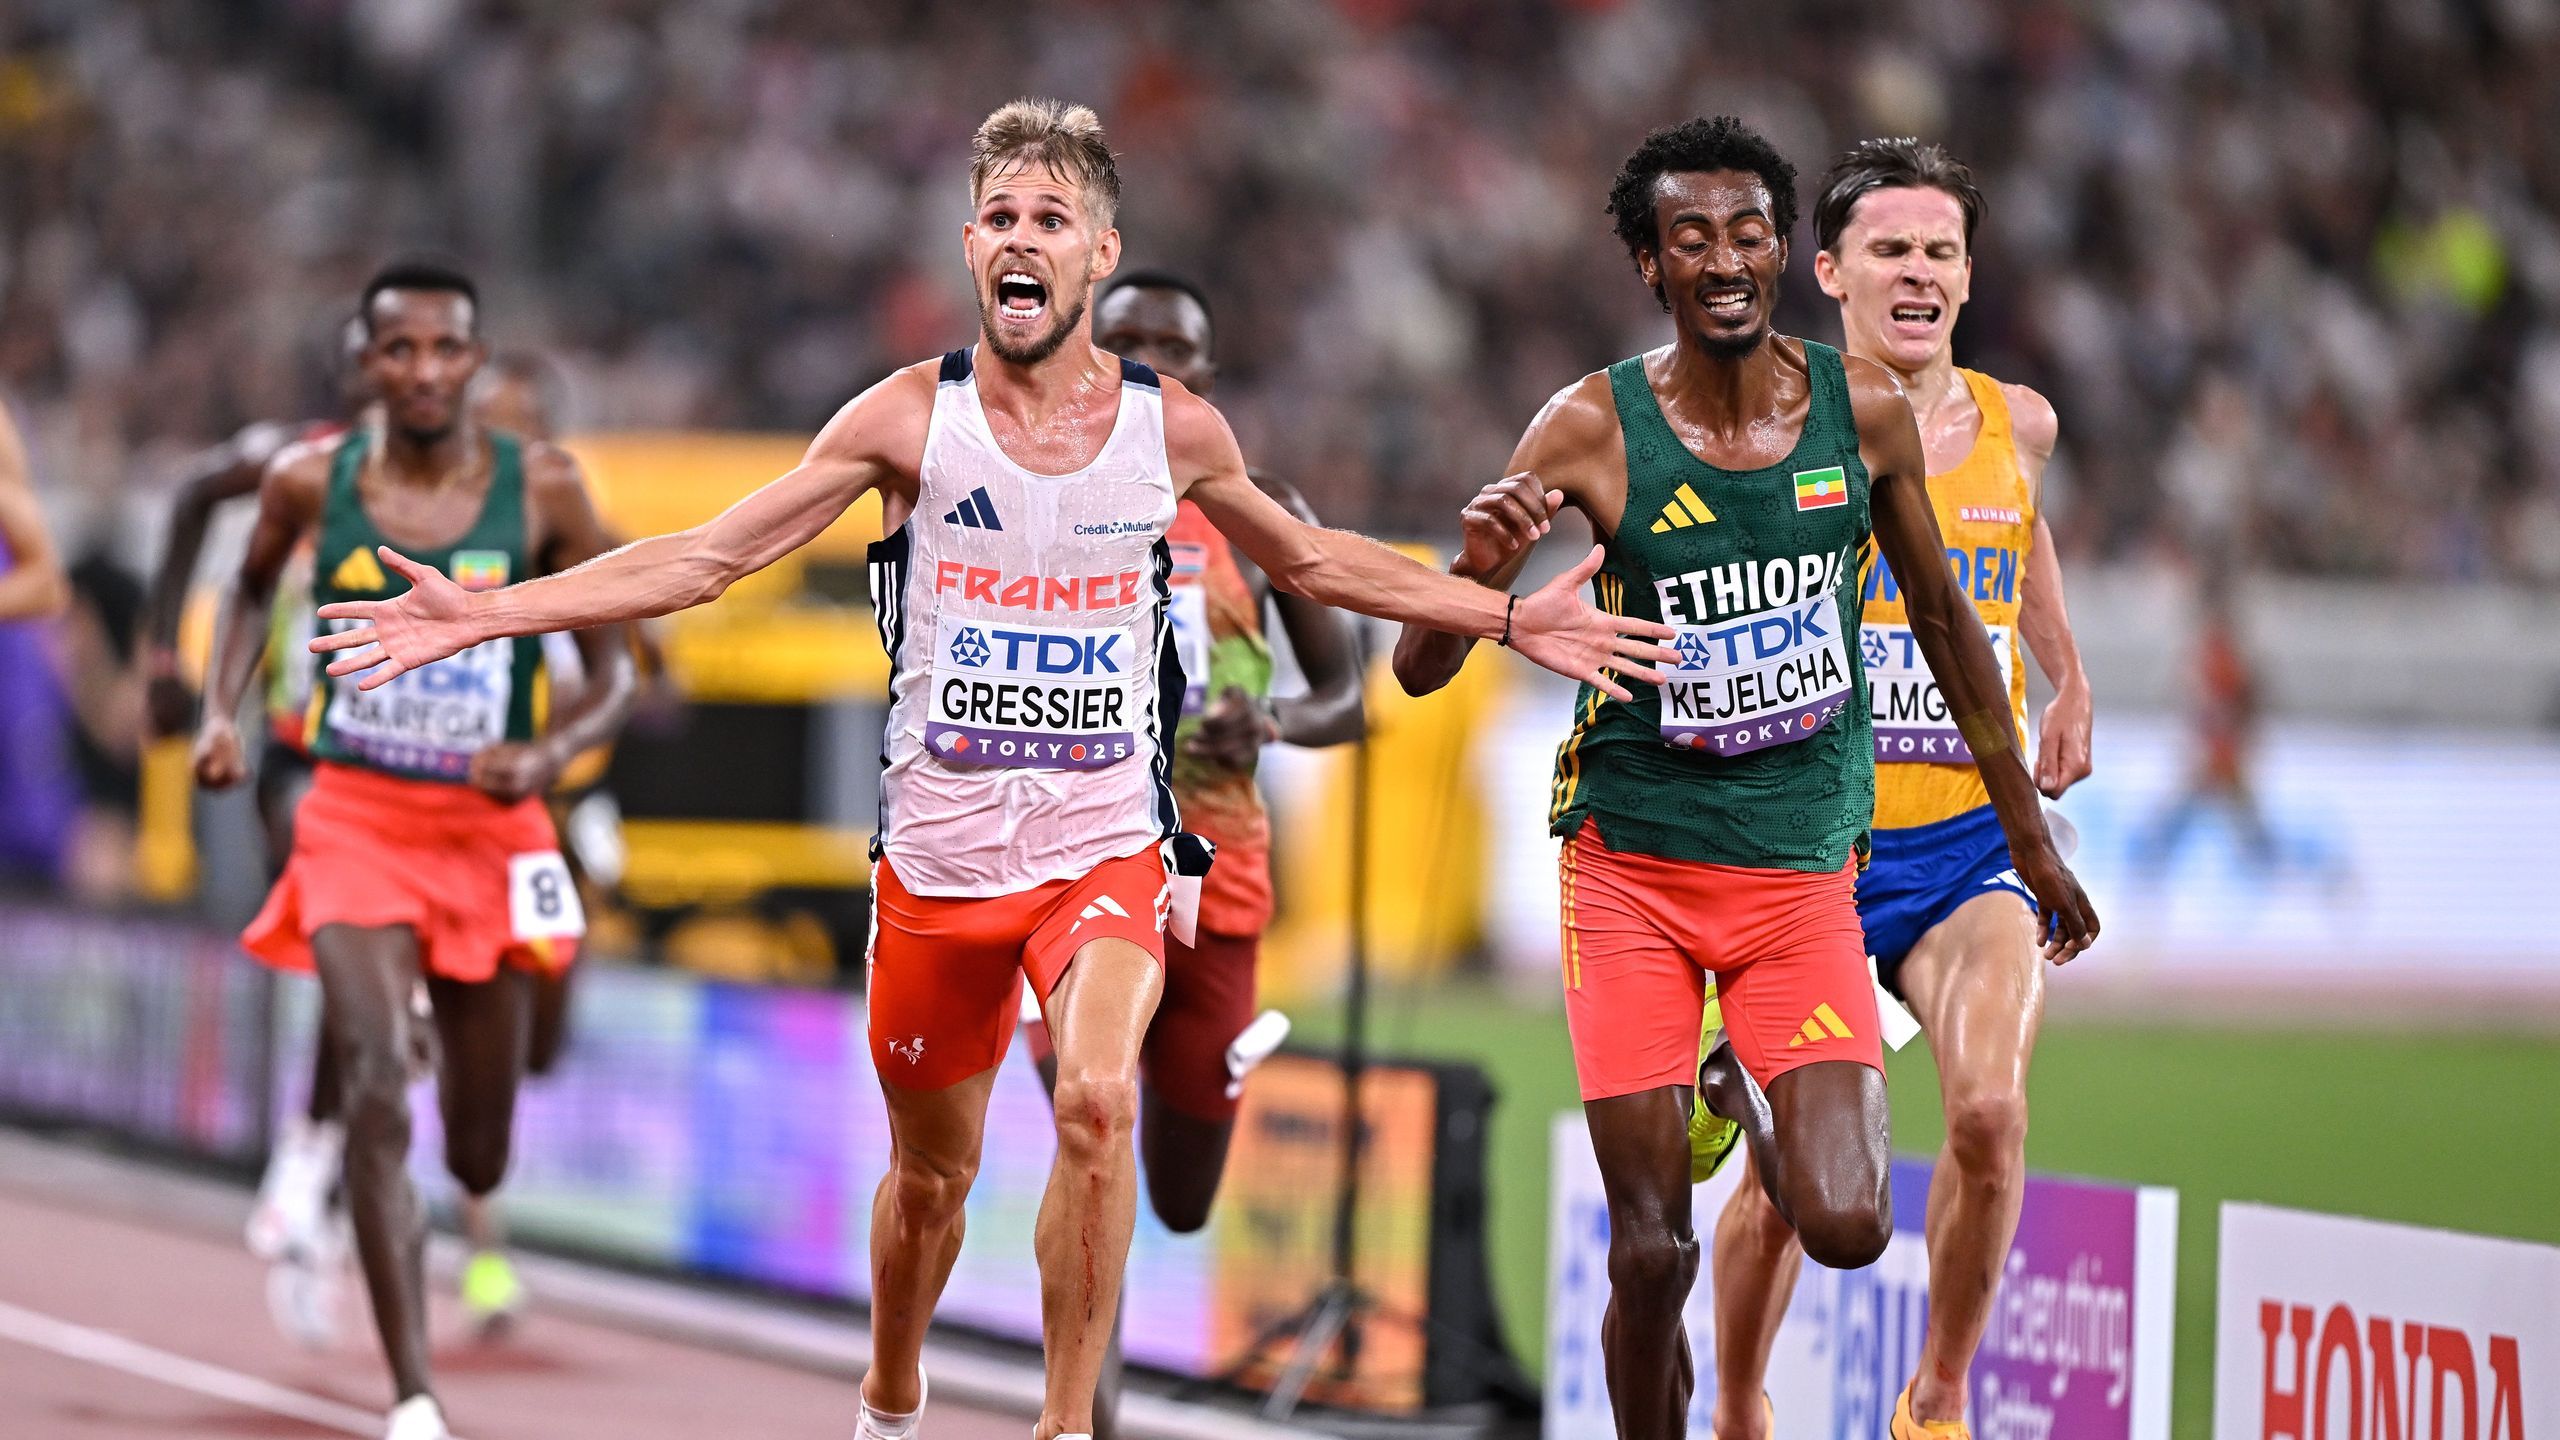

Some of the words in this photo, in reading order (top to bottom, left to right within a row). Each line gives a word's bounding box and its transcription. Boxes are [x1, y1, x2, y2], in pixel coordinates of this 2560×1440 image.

[1074, 524, 1109, 535] Crédit
[1123, 521, 1154, 532] Mutuel
[1961, 507, 2022, 523] BAUHAUS
[935, 560, 1141, 612] FRANCE
[991, 629, 1121, 676] TDK
[1707, 597, 1829, 667] TDK
[942, 677, 1124, 730] GRESSIER
[1668, 647, 1843, 719] KEJELCHA
[1878, 736, 1972, 755] TOKY
[530, 867, 563, 920] 8
[2258, 1300, 2526, 1440] HONDA
